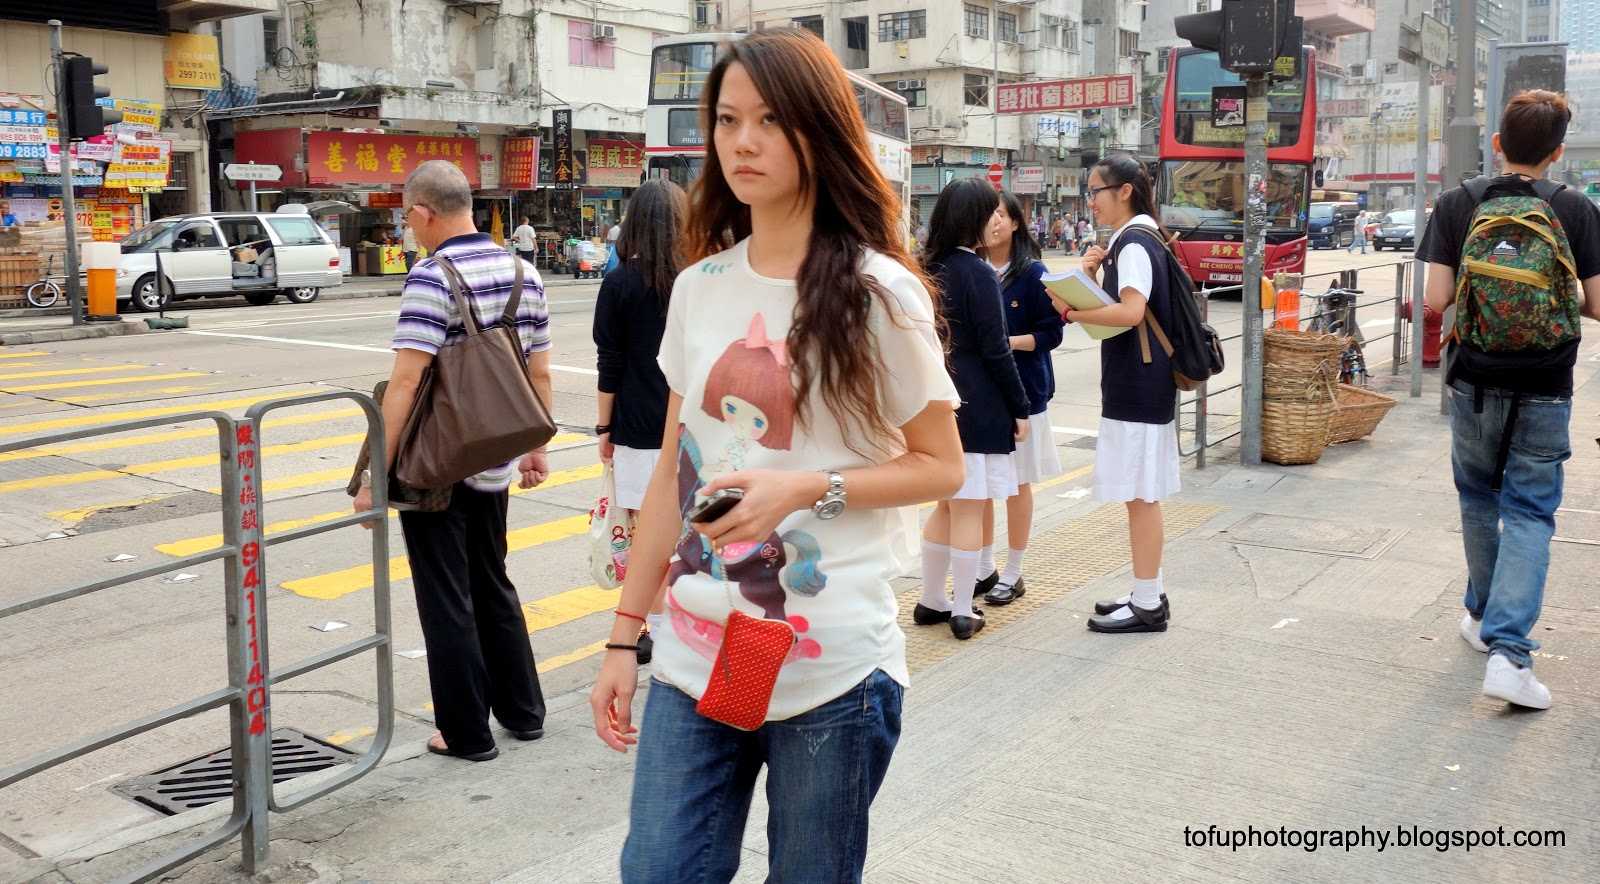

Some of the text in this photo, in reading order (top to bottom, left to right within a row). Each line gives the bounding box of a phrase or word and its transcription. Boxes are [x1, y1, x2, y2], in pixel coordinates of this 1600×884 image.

[194, 53, 216, 61] LEASE
[179, 70, 216, 80] 2997 2111
[1267, 128, 1277, 141] A
[16, 146, 47, 158] 2883
[323, 141, 407, 173] 善福堂
[416, 141, 463, 156] 原藥精製
[1211, 262, 1233, 270] CHENG
[242, 541, 266, 736] 94111404
